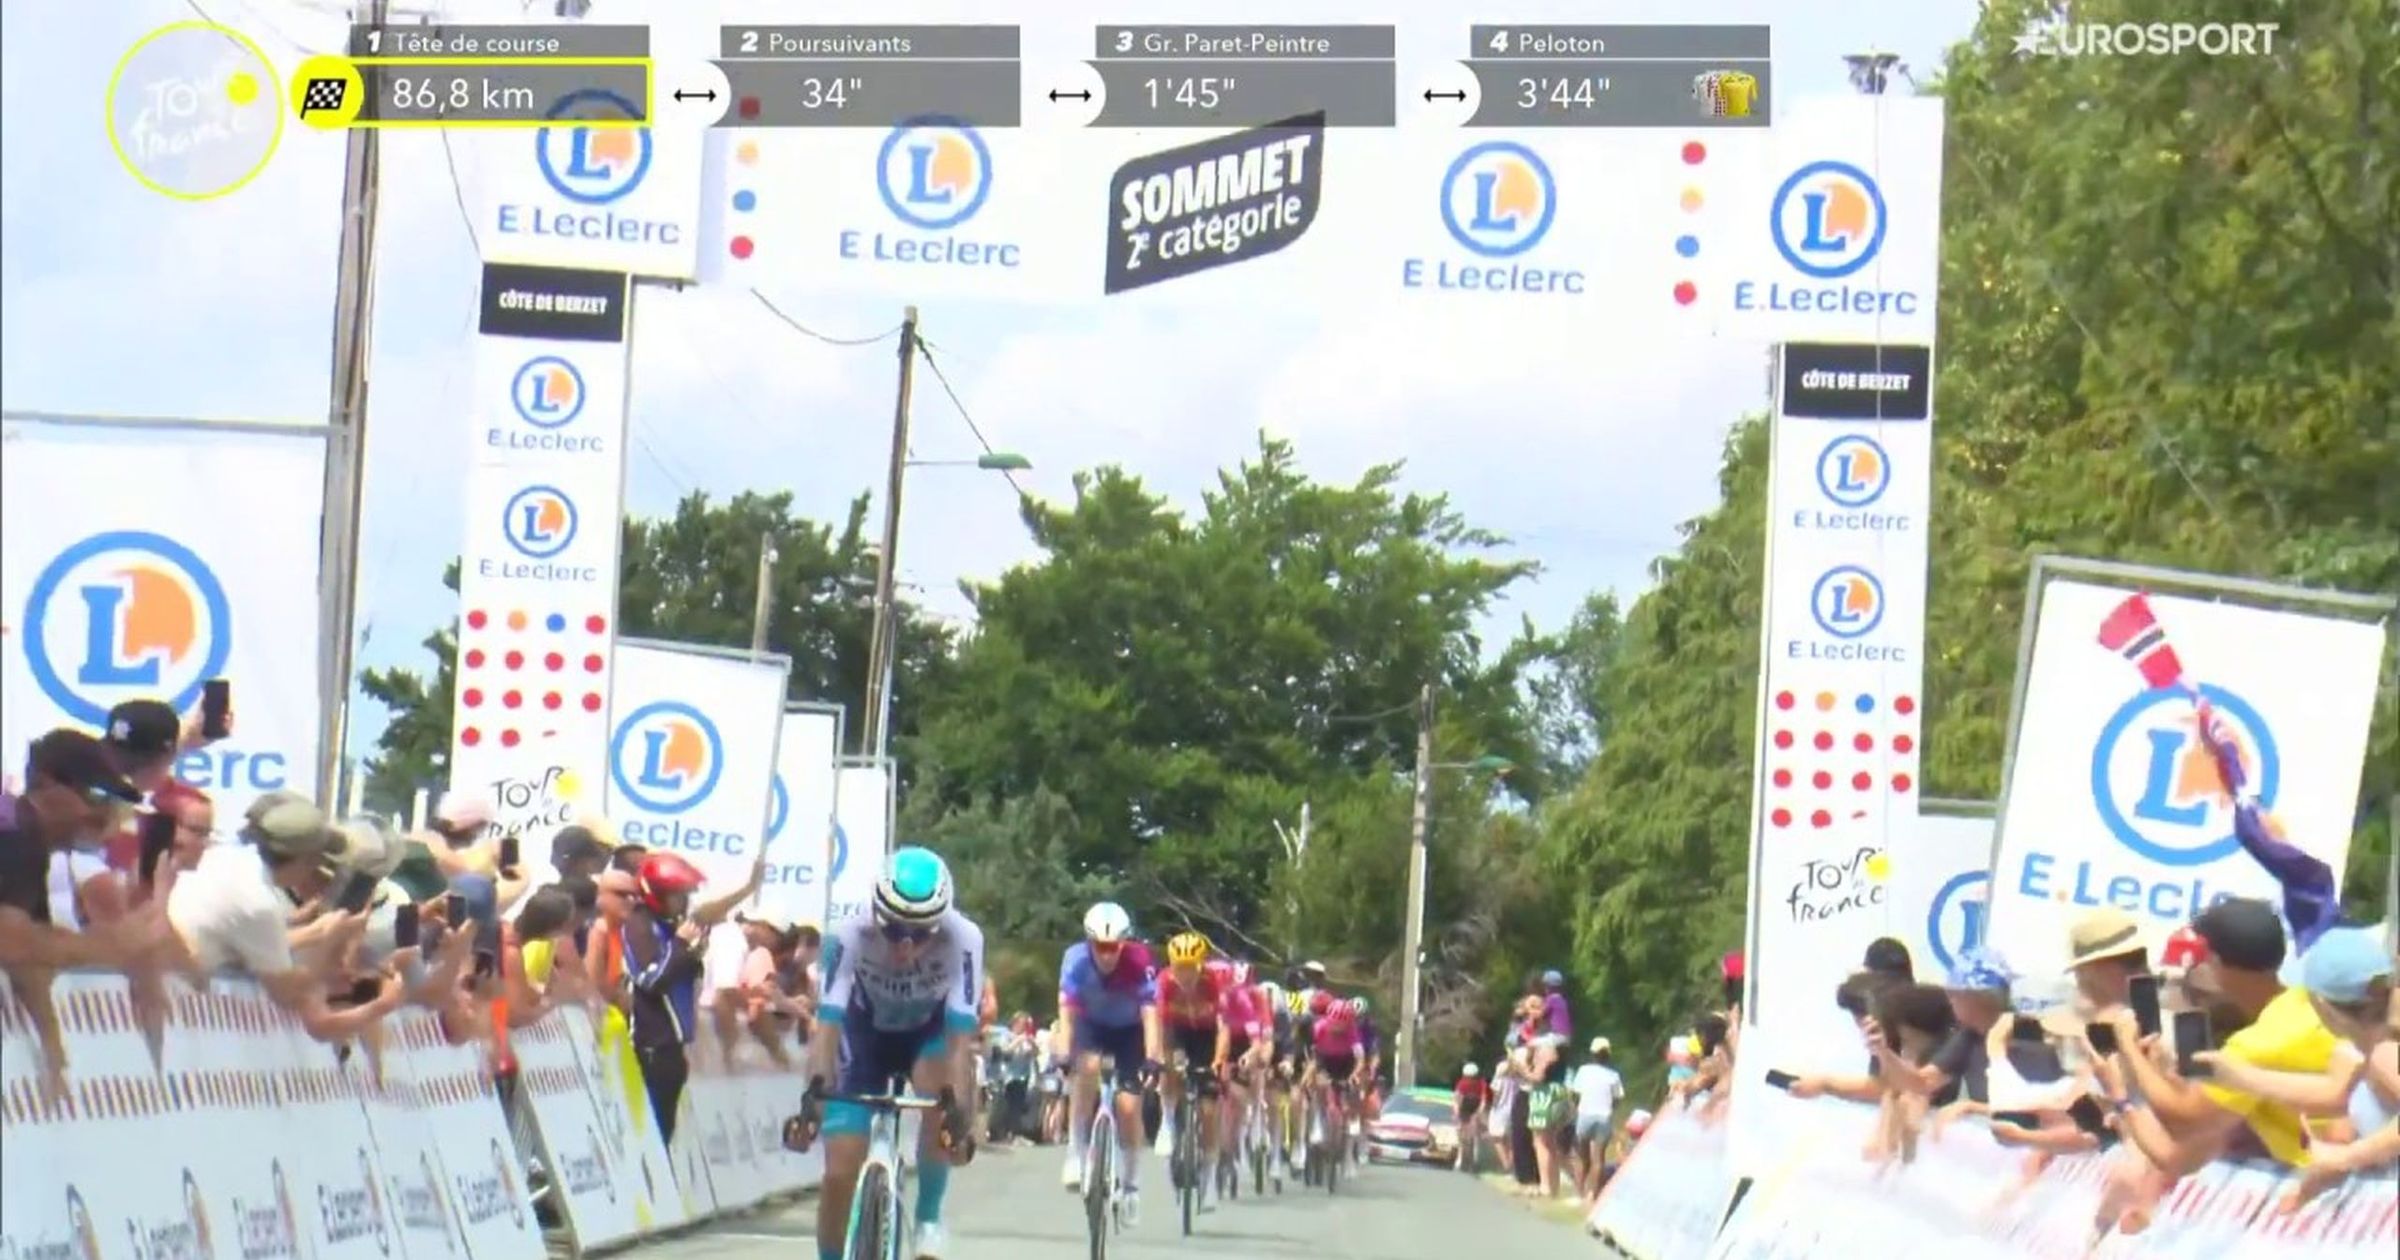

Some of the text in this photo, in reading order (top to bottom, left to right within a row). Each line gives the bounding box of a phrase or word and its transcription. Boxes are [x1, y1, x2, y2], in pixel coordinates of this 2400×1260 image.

[1121, 134, 1312, 231] SOMMET
[1158, 191, 1303, 260] catégorie
[839, 231, 1021, 267] ELeclerc
[1403, 259, 1586, 294] ELeclerc
[1734, 281, 1918, 315] E.Leclerc
[1801, 368, 1836, 389] CÔTE
[487, 428, 604, 453] ELeclerc
[1793, 510, 1910, 532] ELeclerc
[479, 558, 597, 583] ELeclerc
[1787, 640, 1906, 663] ELeclerc
